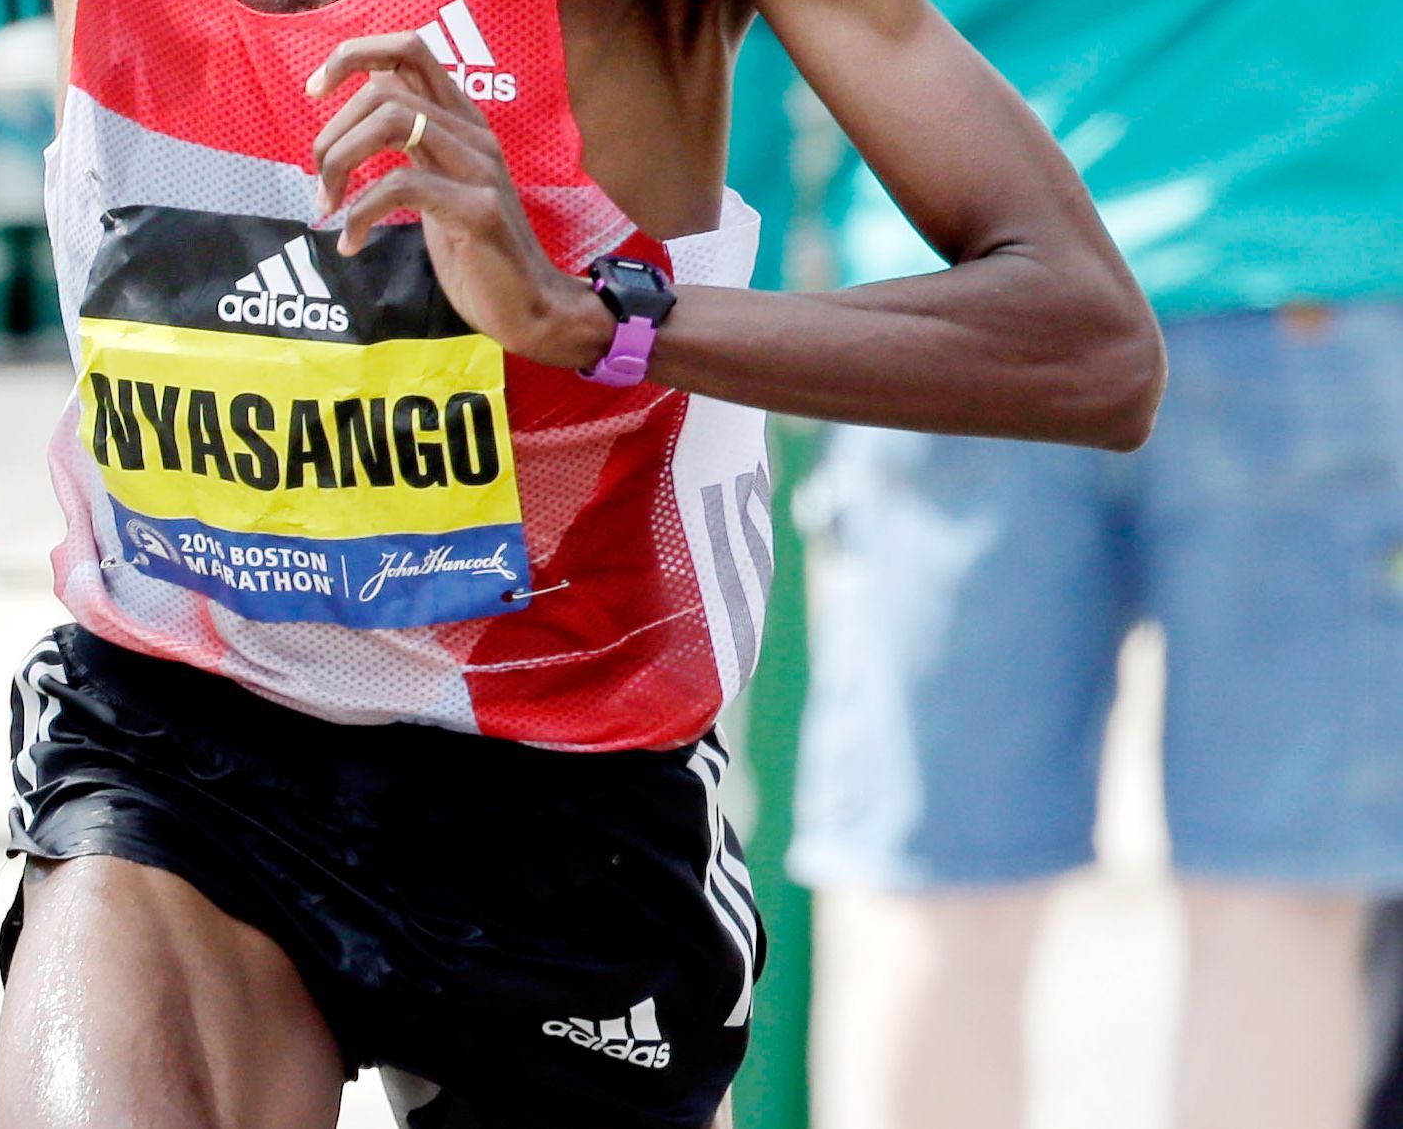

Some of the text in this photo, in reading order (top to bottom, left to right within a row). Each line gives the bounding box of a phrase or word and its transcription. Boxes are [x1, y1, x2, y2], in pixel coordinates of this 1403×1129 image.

[448, 63, 517, 103] das
[217, 290, 350, 333] adidas
[90, 372, 501, 492] NYASANGO
[229, 546, 328, 573] BOSTON
[358, 550, 418, 603] John
[541, 1020, 671, 1067] adidas
